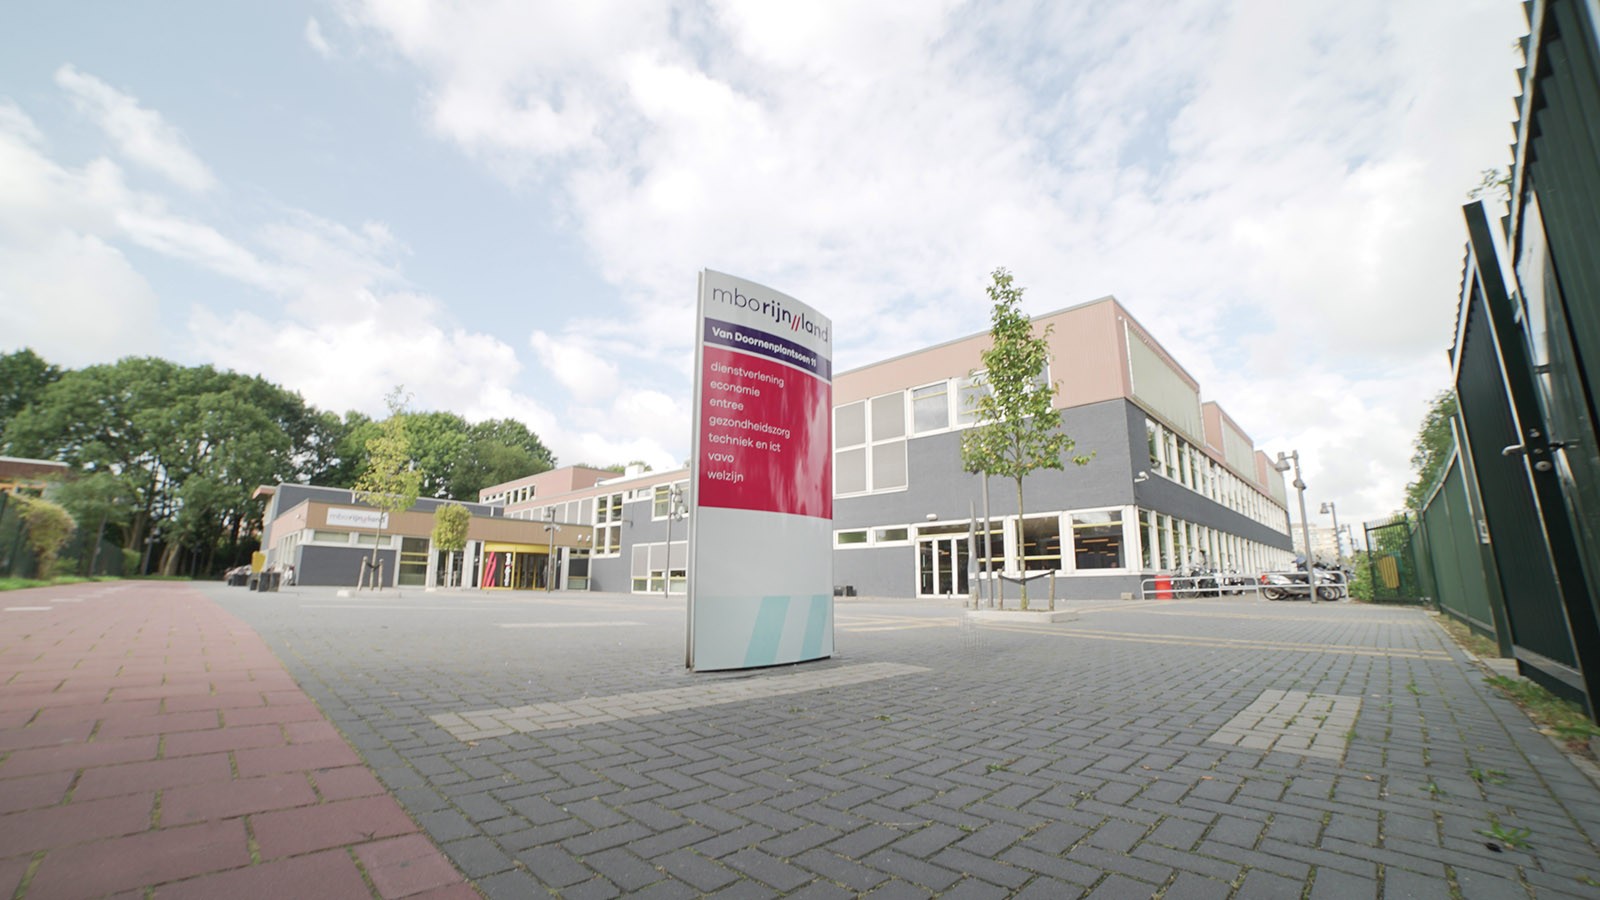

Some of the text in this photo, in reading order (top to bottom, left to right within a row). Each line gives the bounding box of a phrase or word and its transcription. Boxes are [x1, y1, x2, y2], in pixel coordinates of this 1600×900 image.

[712, 326, 817, 367] Van Doornenplantsoen 11
[710, 361, 785, 388] dienstverlening
[710, 380, 760, 397] economie
[709, 398, 744, 411] entree
[708, 416, 791, 440] gezondheidszorg
[708, 432, 781, 452] techniek en ict
[708, 451, 734, 463] vavo
[707, 471, 744, 484] welzijn
